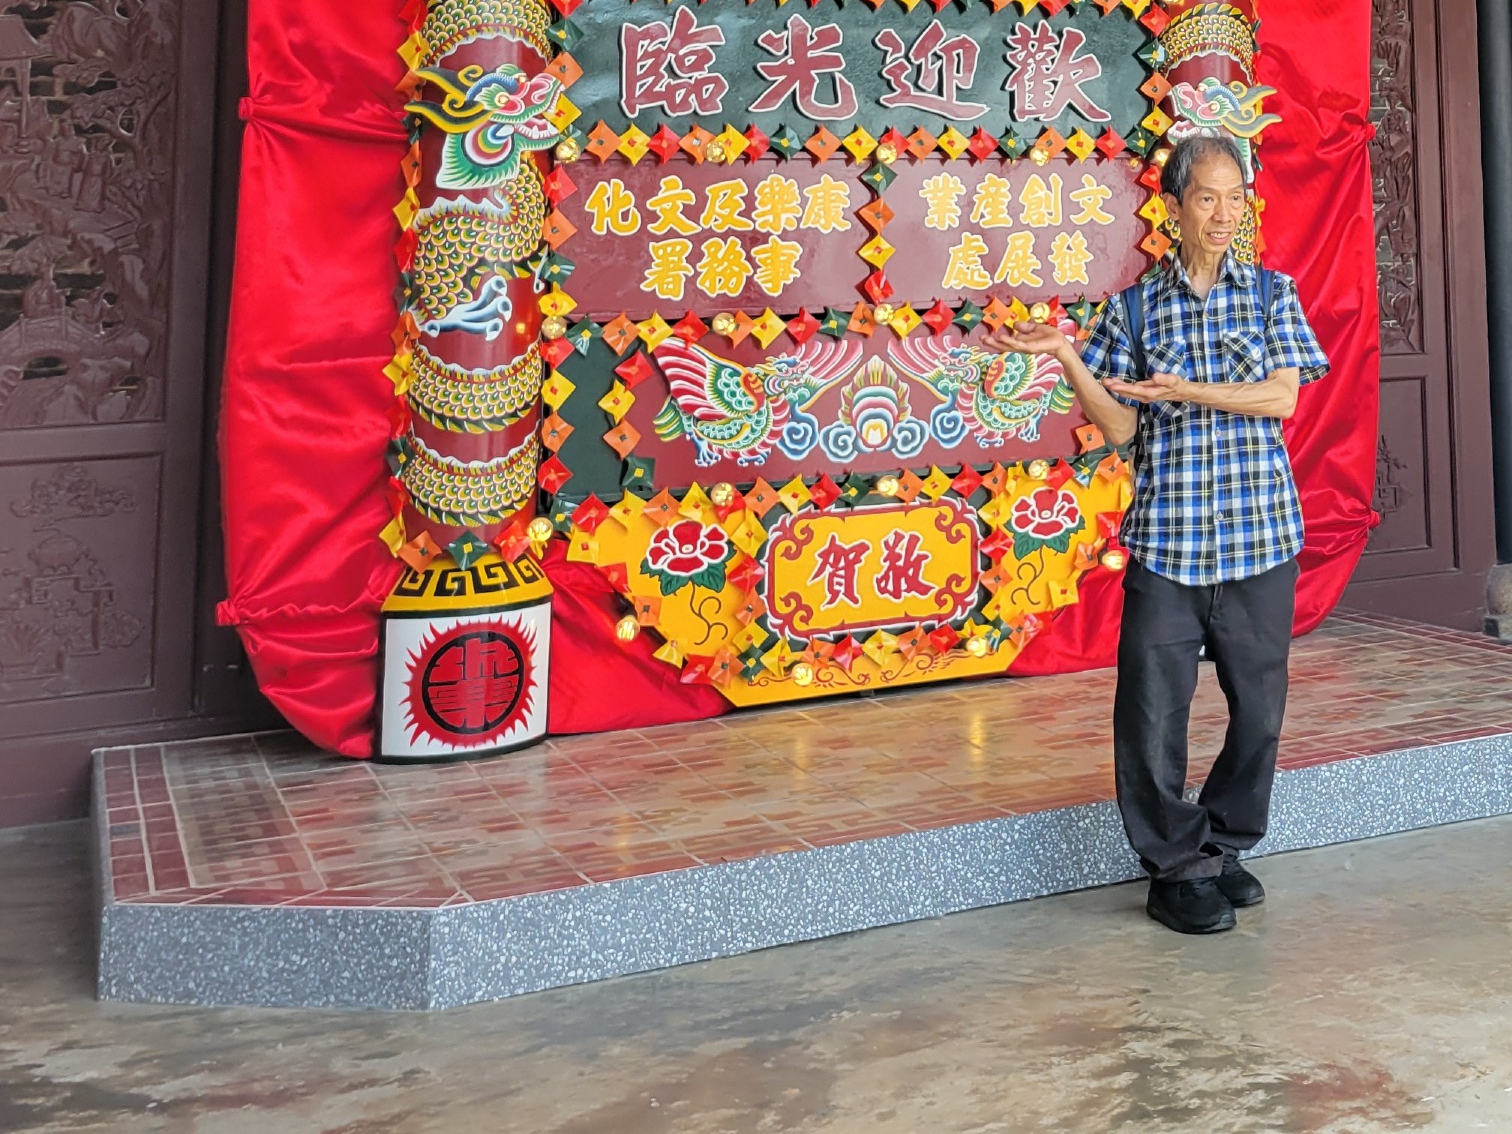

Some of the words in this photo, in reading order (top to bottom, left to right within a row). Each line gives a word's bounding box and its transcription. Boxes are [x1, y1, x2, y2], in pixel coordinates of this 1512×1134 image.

[620, 5, 1111, 123] 歡迎光臨
[585, 173, 852, 236] 康樂及文化
[919, 172, 1115, 230] 文創產業
[640, 235, 803, 301] 事務署
[941, 230, 1094, 290] 發展處
[807, 529, 937, 610] 敬賀
